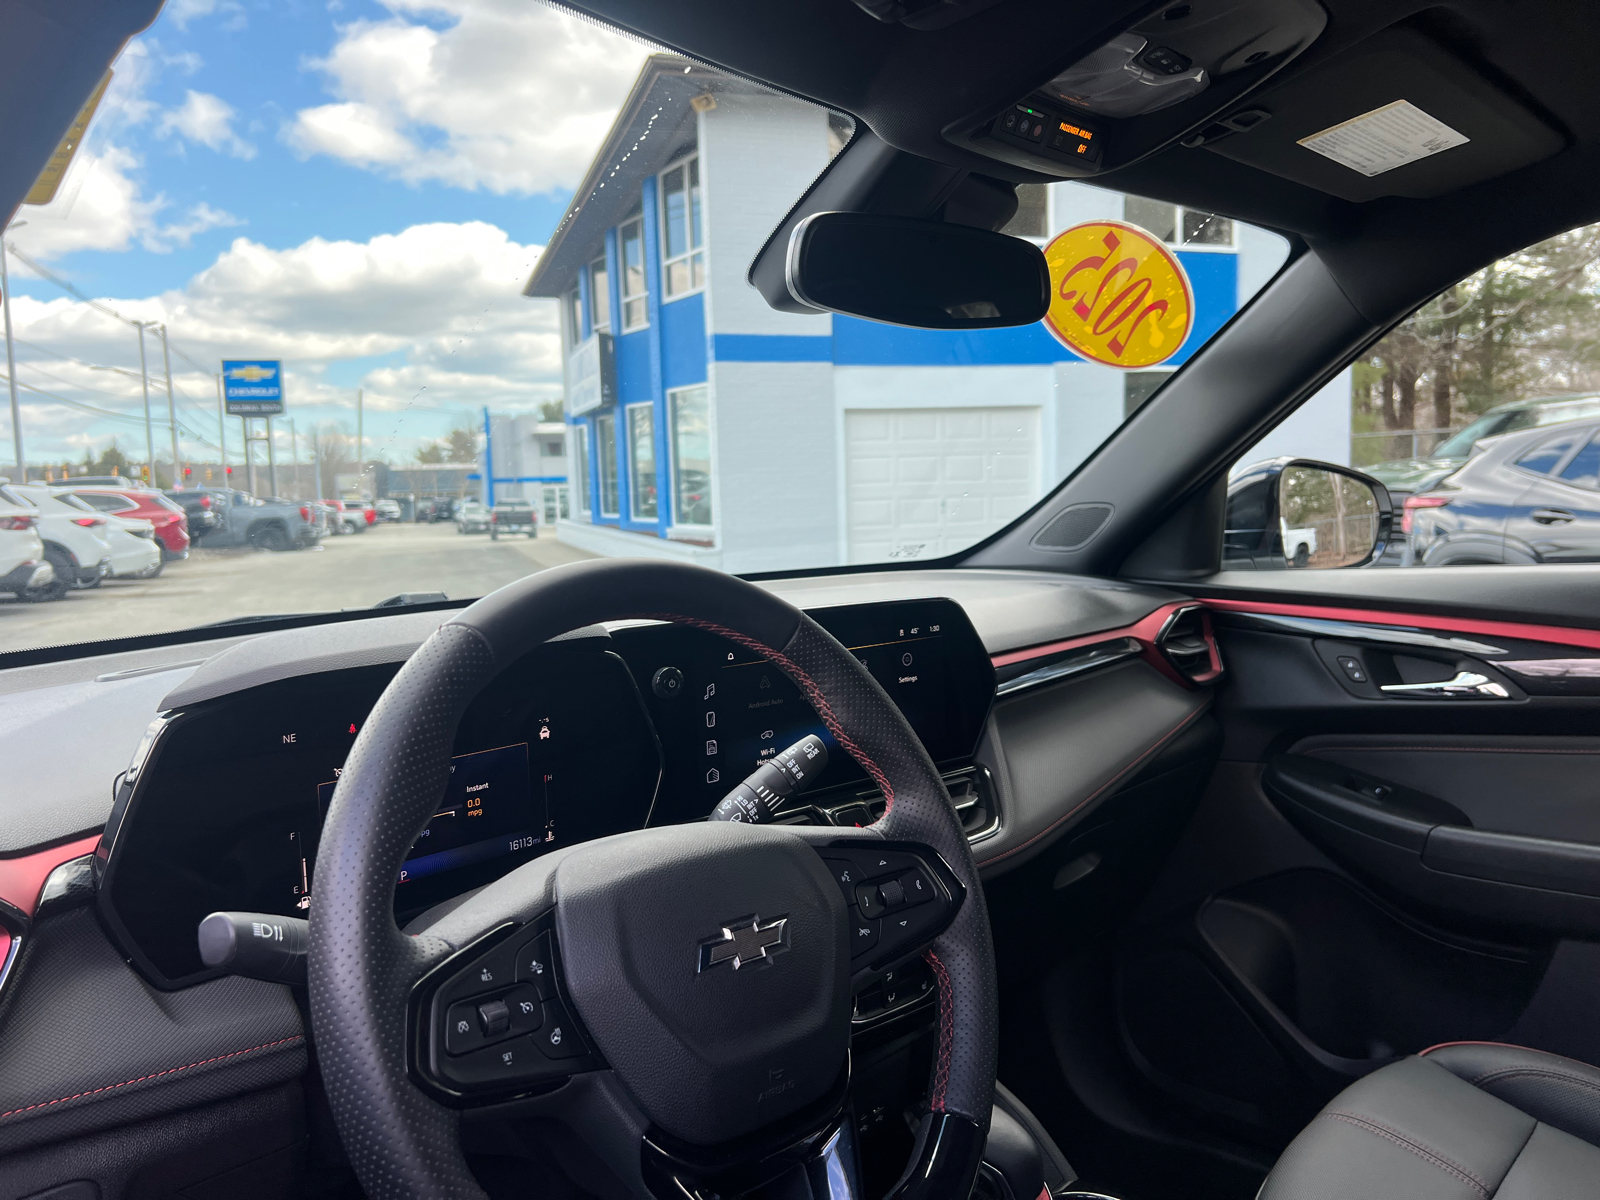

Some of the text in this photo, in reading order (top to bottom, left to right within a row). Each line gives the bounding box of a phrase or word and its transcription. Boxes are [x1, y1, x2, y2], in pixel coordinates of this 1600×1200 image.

[1059, 122, 1080, 136] PASSENGER
[1077, 143, 1087, 154] OFF
[229, 387, 280, 397] CHEVROLET
[898, 675, 918, 684] Settings
[748, 698, 784, 709] Android Auto
[283, 733, 297, 744] NE
[760, 747, 776, 757] Wi-Fi
[807, 748, 820, 760] REAR
[787, 759, 796, 768] OFF
[795, 771, 804, 780] ON
[466, 782, 489, 793] Instant
[467, 797, 481, 808] 0.0
[467, 808, 483, 817] mpg
[748, 807, 758, 816] OFF
[290, 832, 295, 840] F
[400, 870, 408, 881] P
[293, 886, 299, 894] E
[481, 972, 493, 982] RES
[502, 1052, 513, 1062] SET
